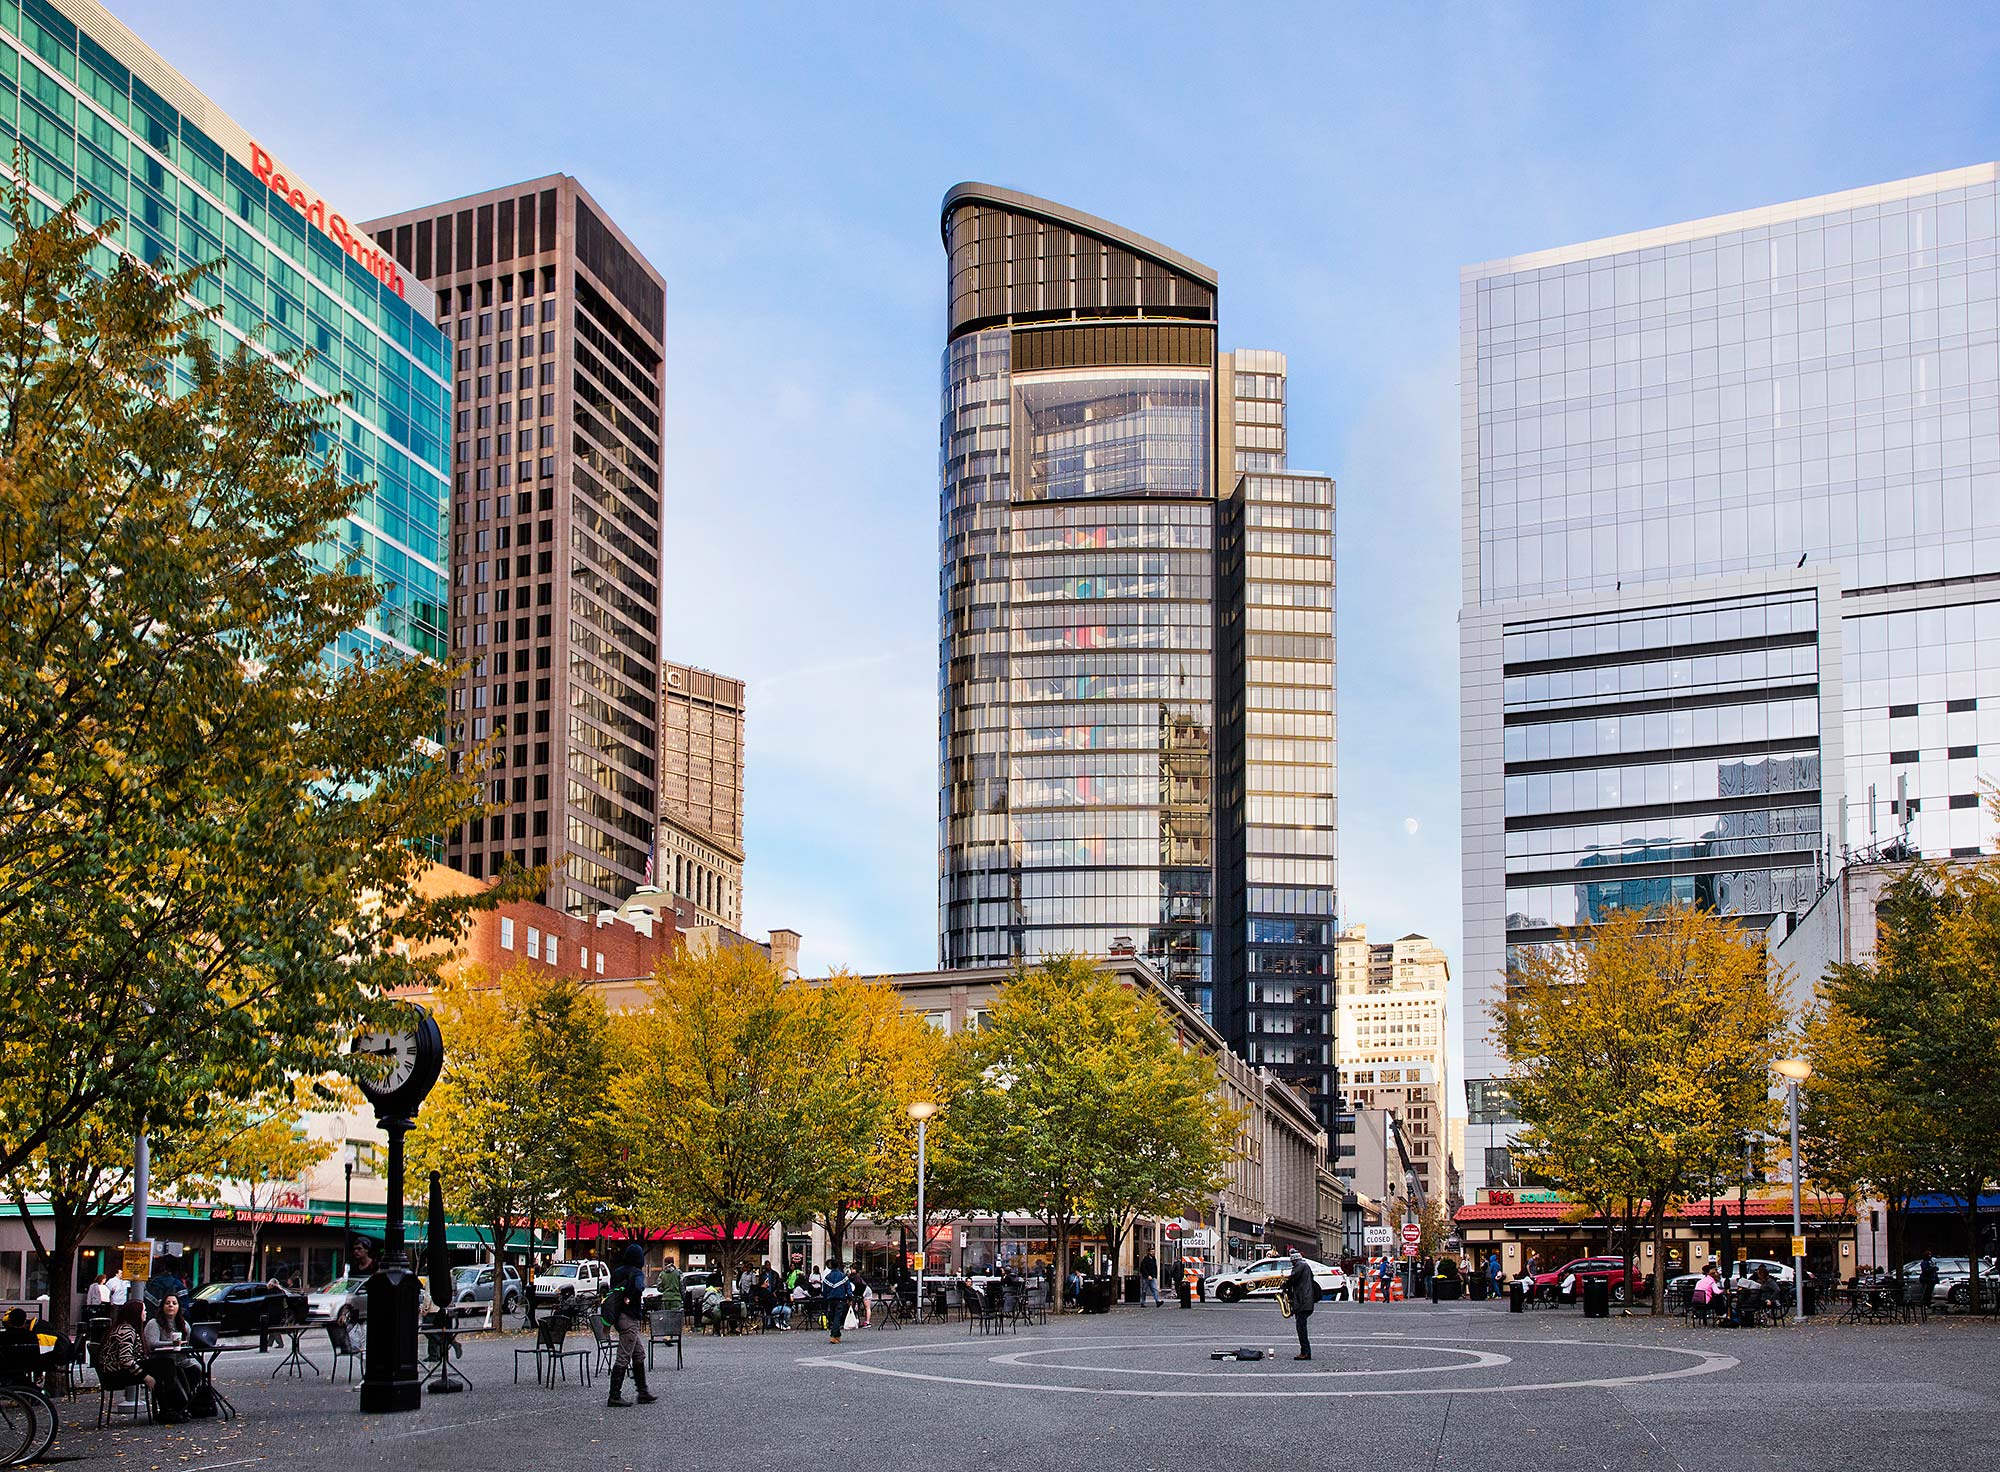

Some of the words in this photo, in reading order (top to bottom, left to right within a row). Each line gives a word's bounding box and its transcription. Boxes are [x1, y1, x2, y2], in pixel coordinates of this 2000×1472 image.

[249, 141, 325, 232] Reed
[329, 213, 405, 299] Smith
[275, 1212, 306, 1224] MARKET
[215, 1238, 254, 1247] ENTRANCE
